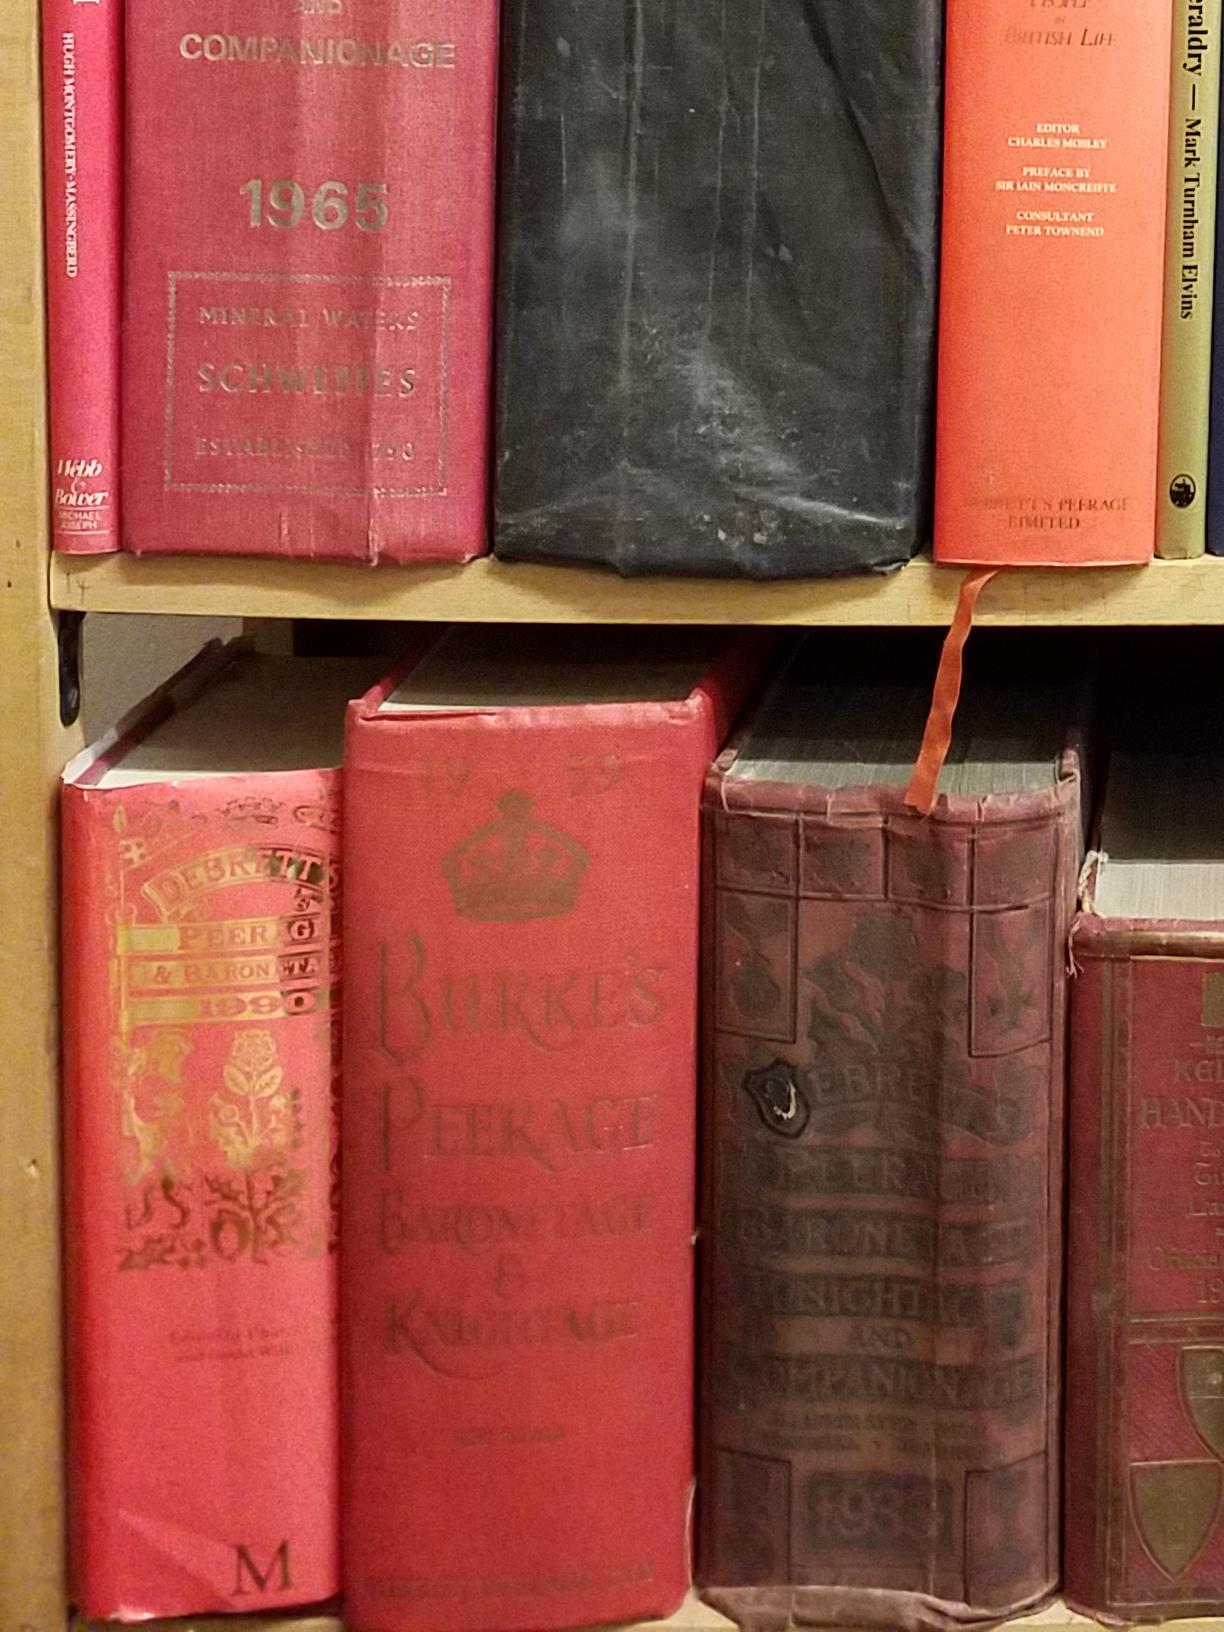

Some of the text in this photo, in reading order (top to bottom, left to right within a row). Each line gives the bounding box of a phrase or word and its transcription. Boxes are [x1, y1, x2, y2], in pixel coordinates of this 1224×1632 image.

[62, 32, 75, 74] HUGH
[179, 33, 455, 68] COMPANIONAGE
[1008, 137, 1061, 148] CHARLES
[1036, 123, 1080, 134] EDITOR
[1184, 117, 1201, 168] Mark
[1022, 166, 1091, 179] PREFACE BY
[239, 179, 389, 231] 1965
[1016, 211, 1094, 222] CONSULTANT
[1181, 174, 1201, 258] Turnham
[1180, 264, 1198, 320] Elvins
[231, 1539, 292, 1597] M
